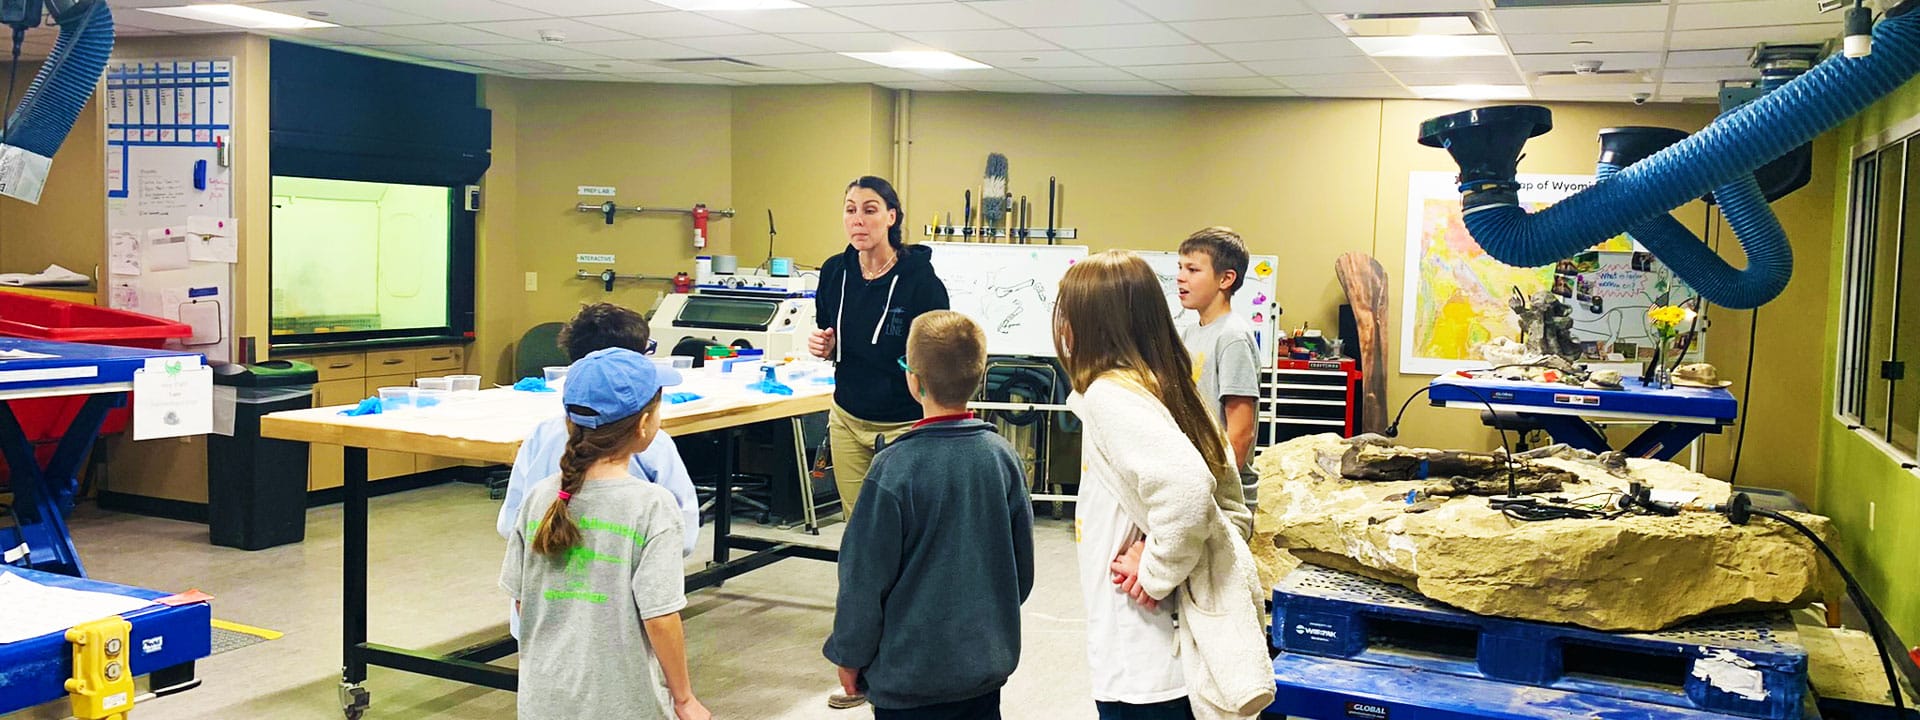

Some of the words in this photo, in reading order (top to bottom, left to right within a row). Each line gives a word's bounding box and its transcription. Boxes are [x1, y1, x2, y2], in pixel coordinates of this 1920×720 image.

[1519, 181, 1534, 191] ap
[1536, 180, 1550, 190] of
[1551, 180, 1594, 193] Wyomi
[1353, 703, 1386, 715] GLOBAL
